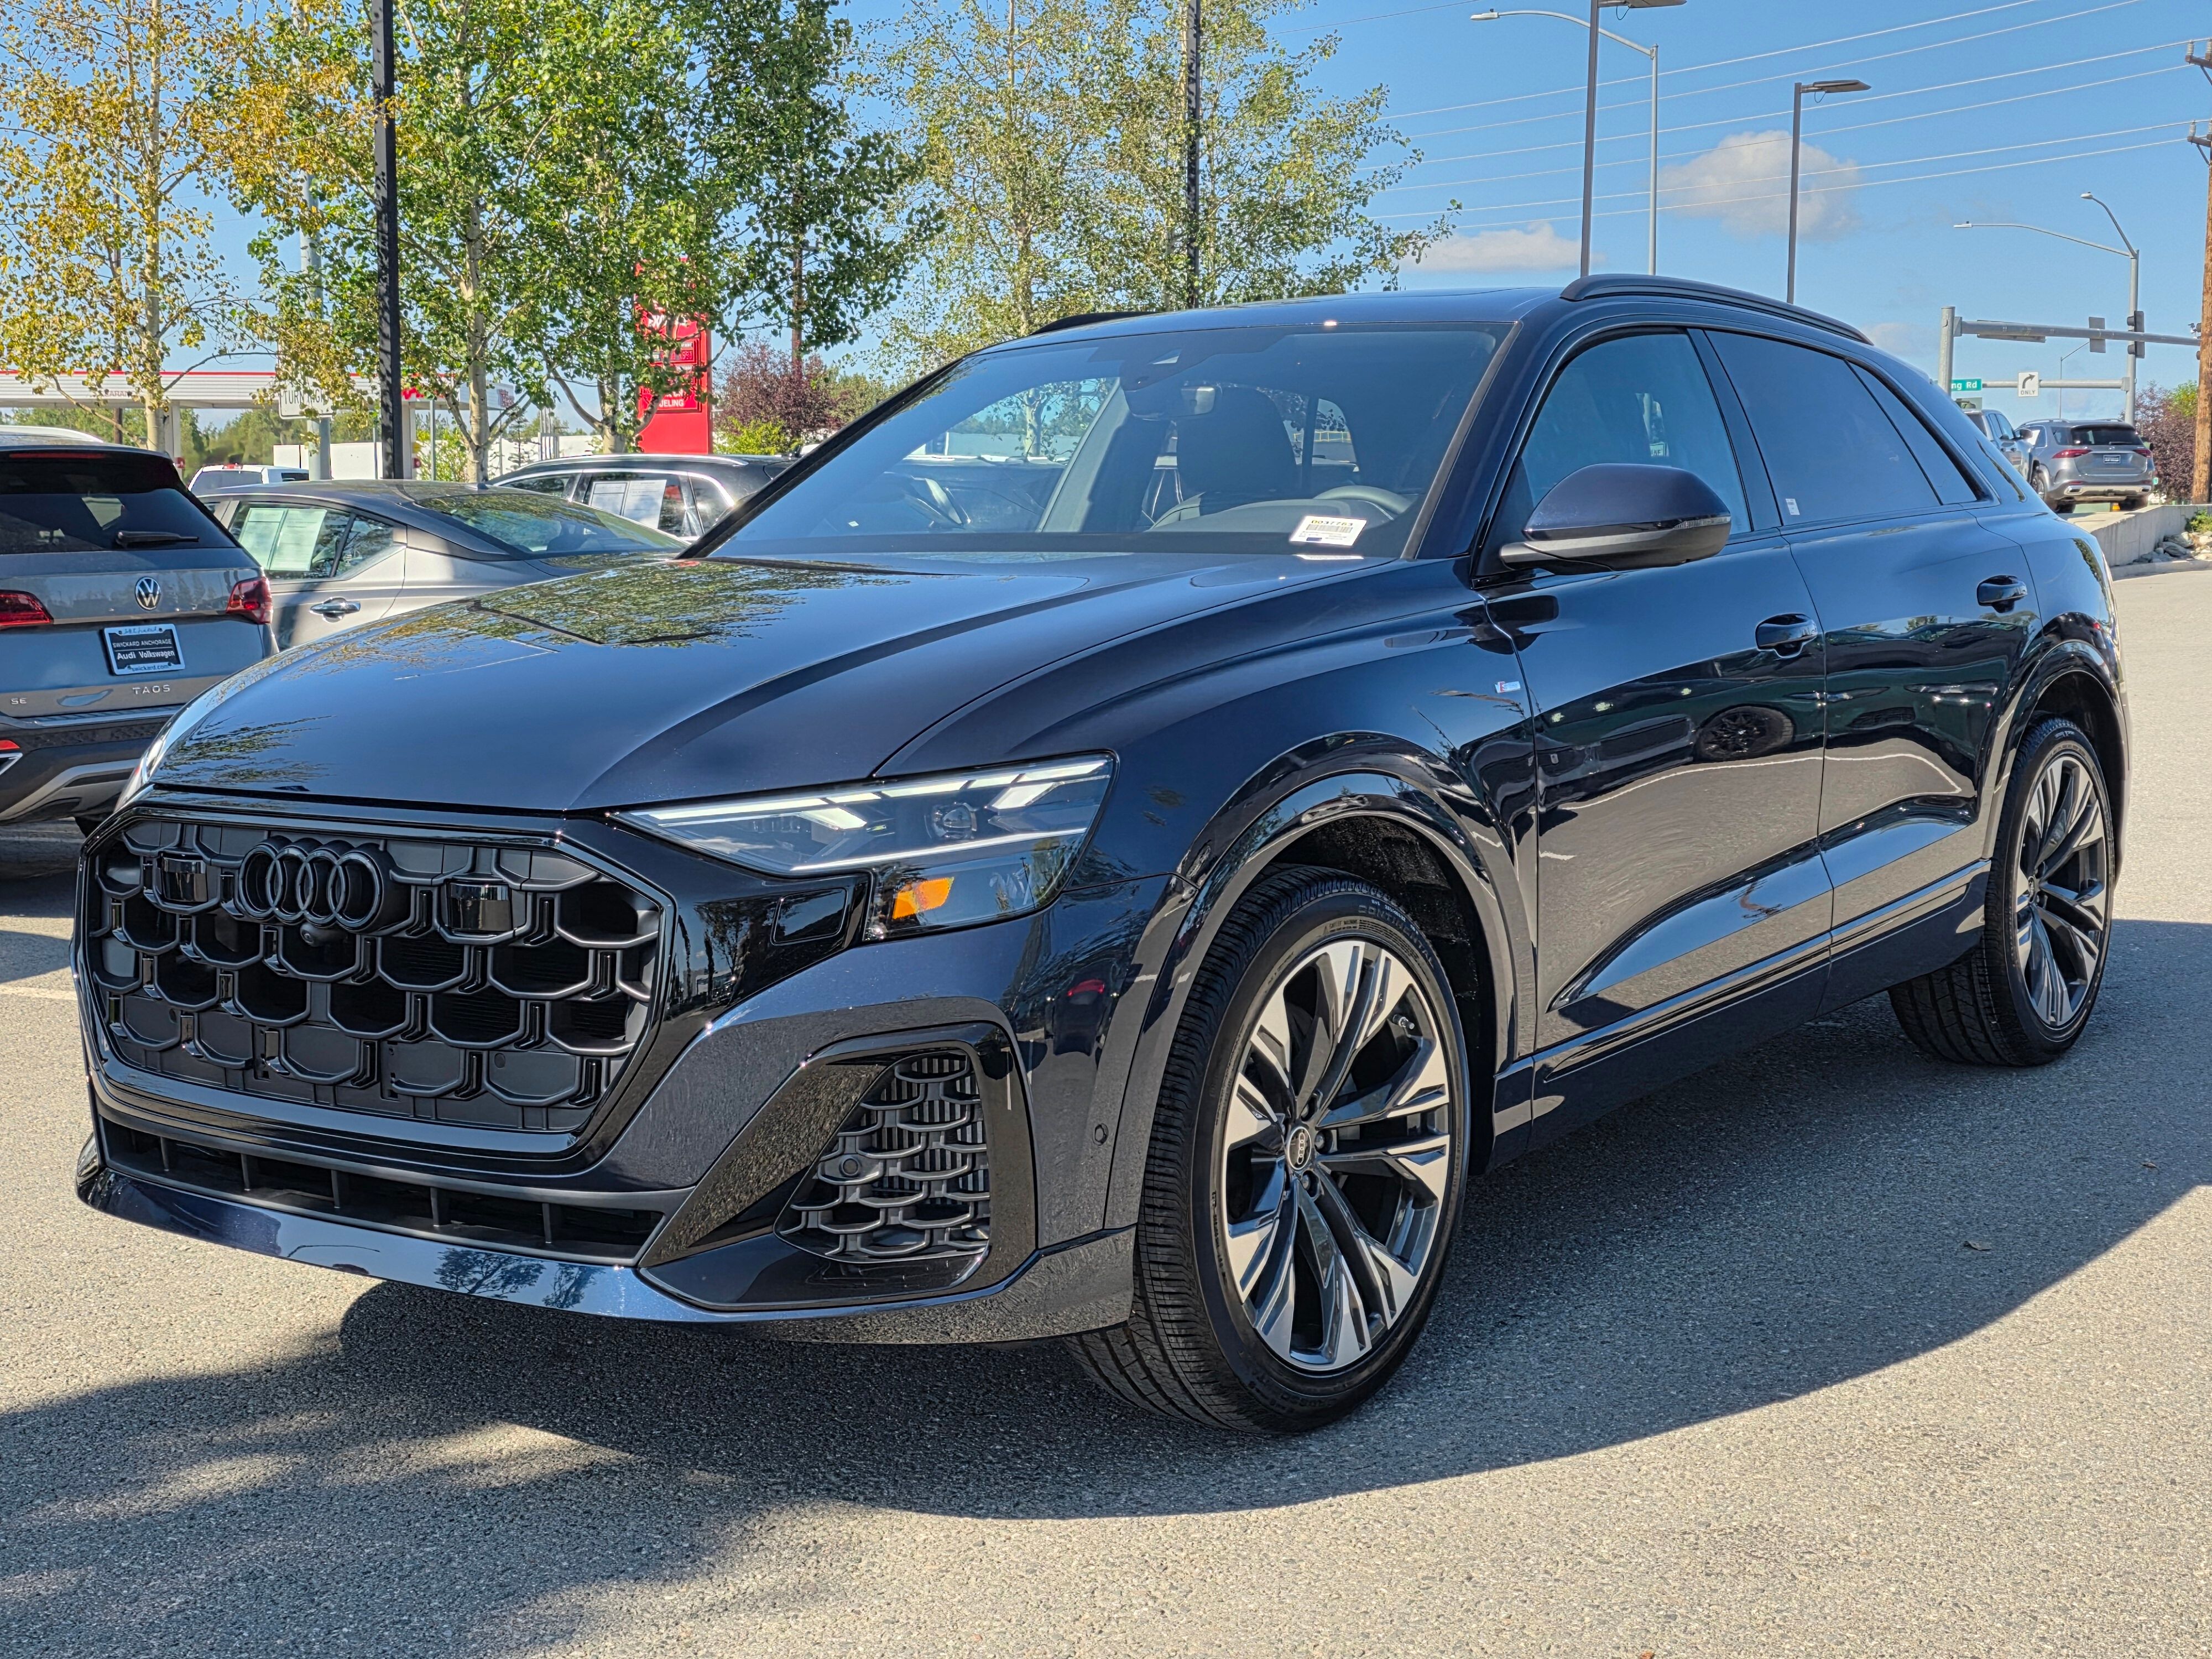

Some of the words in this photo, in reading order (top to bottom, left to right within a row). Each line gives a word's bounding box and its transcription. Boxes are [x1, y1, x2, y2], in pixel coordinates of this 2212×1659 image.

[283, 390, 304, 404] TURN
[117, 651, 136, 660] Audi
[139, 650, 175, 659] Volkswagen
[132, 685, 170, 695] TAOS
